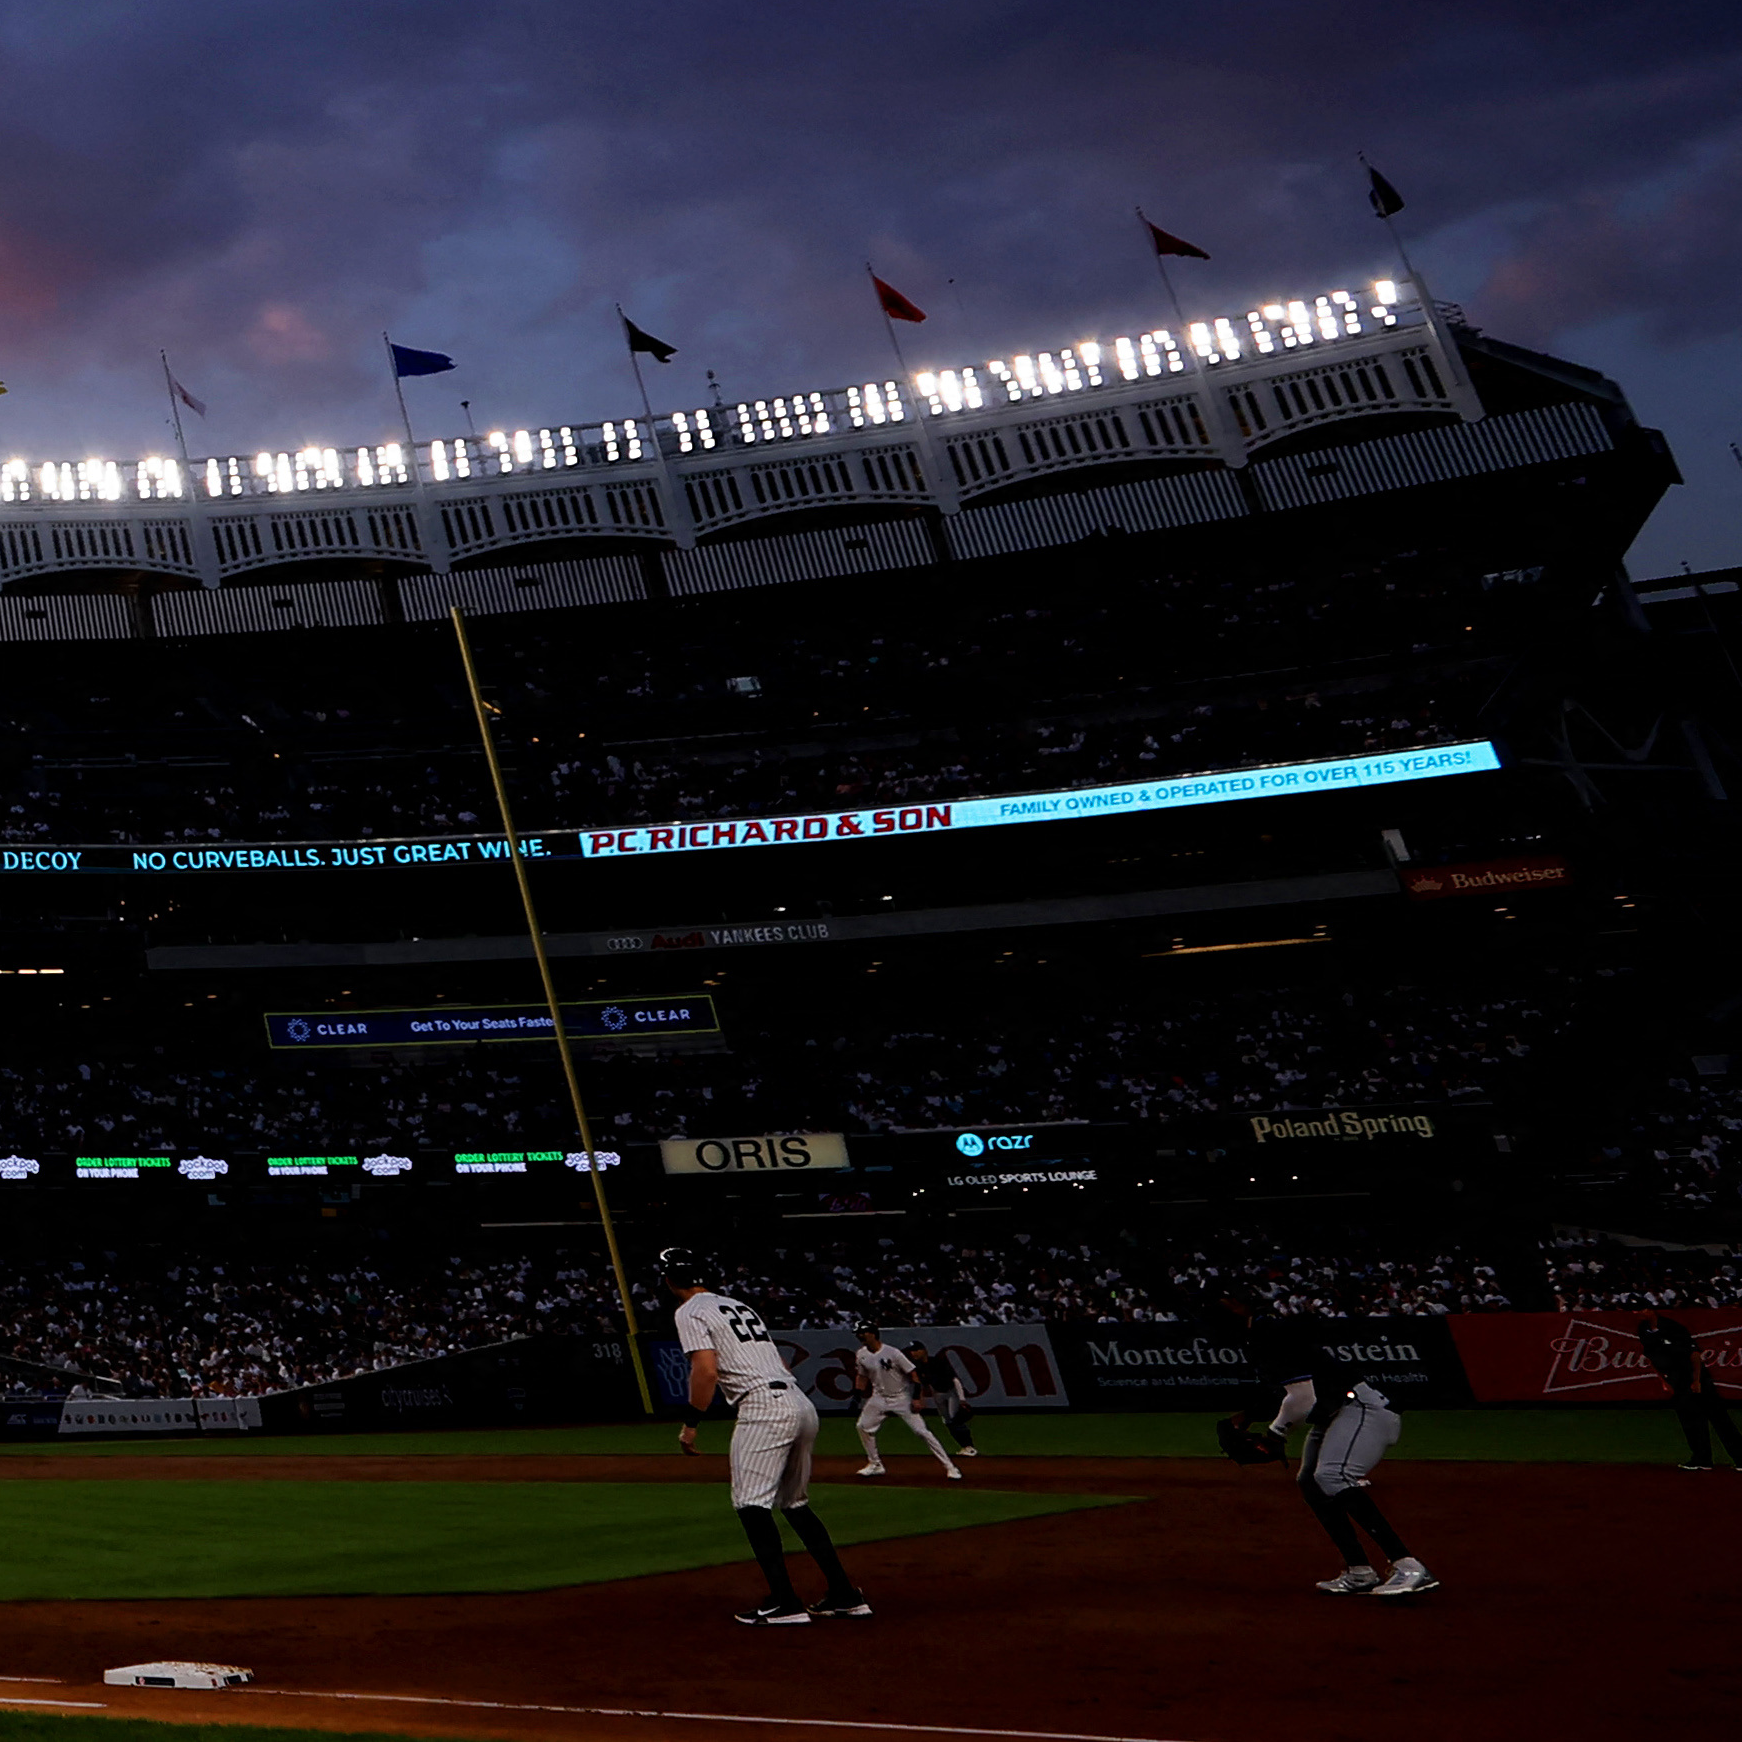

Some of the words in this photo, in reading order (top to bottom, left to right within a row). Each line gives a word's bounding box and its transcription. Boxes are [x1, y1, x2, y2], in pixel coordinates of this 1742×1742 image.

[1000, 798, 1061, 818] FAMILY
[1065, 791, 1134, 810] OWNED
[1139, 787, 1151, 803] &
[1156, 778, 1255, 801] OPERATED
[1260, 772, 1298, 790] FOR
[1305, 764, 1357, 785] OVER
[1363, 761, 1395, 777] 115
[1400, 751, 1471, 773] YEARS!
[650, 818, 827, 850] RICHARD
[837, 815, 864, 837] &
[873, 806, 951, 833] SON
[2, 851, 82, 871] DECOY
[132, 852, 166, 871] NO
[172, 849, 326, 869] CURVEBALLS.
[331, 846, 387, 866] JUST
[393, 842, 471, 864] GREAT
[1450, 867, 1565, 888] Budweiser
[651, 932, 705, 949] Audi
[710, 927, 783, 945] YANKEES
[787, 924, 830, 939] CLUB
[634, 1009, 691, 1022] CLEAR
[317, 1023, 368, 1035] CLEAR
[410, 1020, 434, 1032] Get
[436, 1019, 451, 1031] To
[451, 1019, 480, 1031] Your
[480, 1018, 517, 1029] Seats
[518, 1017, 555, 1028] Faste
[1250, 1112, 1341, 1143] Poland
[1339, 1112, 1435, 1141] Spring
[987, 1135, 1034, 1150] razr
[76, 1157, 103, 1167] ORDER
[104, 1157, 137, 1167] LOTTERY
[138, 1157, 171, 1167] TICKETS
[267, 1157, 293, 1167] ORDER
[294, 1157, 326, 1166] LOTTERY
[327, 1156, 358, 1166] TICKETS
[454, 1153, 485, 1163] ORDER
[487, 1152, 525, 1163] LOTTERY
[526, 1151, 564, 1161] TICKETS
[696, 1137, 811, 1170] ORIS
[76, 1167, 89, 1178] ON
[90, 1167, 111, 1178] YOUR
[111, 1167, 139, 1178] PHONE
[268, 1166, 280, 1176] ON
[280, 1166, 301, 1176] YOUR
[301, 1166, 328, 1176] PHONE
[455, 1163, 470, 1173] ON
[471, 1163, 495, 1173] YOUR
[495, 1162, 527, 1173] PHONE
[947, 1176, 964, 1186] LG
[965, 1175, 998, 1185] OLED
[998, 1172, 1047, 1184] SPORTS
[1047, 1170, 1098, 1182] LOUNGE
[719, 1305, 770, 1342] 22
[592, 1343, 622, 1359] 318
[1086, 1337, 1249, 1367] Montefio
[1322, 1335, 1421, 1362] stein
[769, 1339, 1057, 1400] aon
